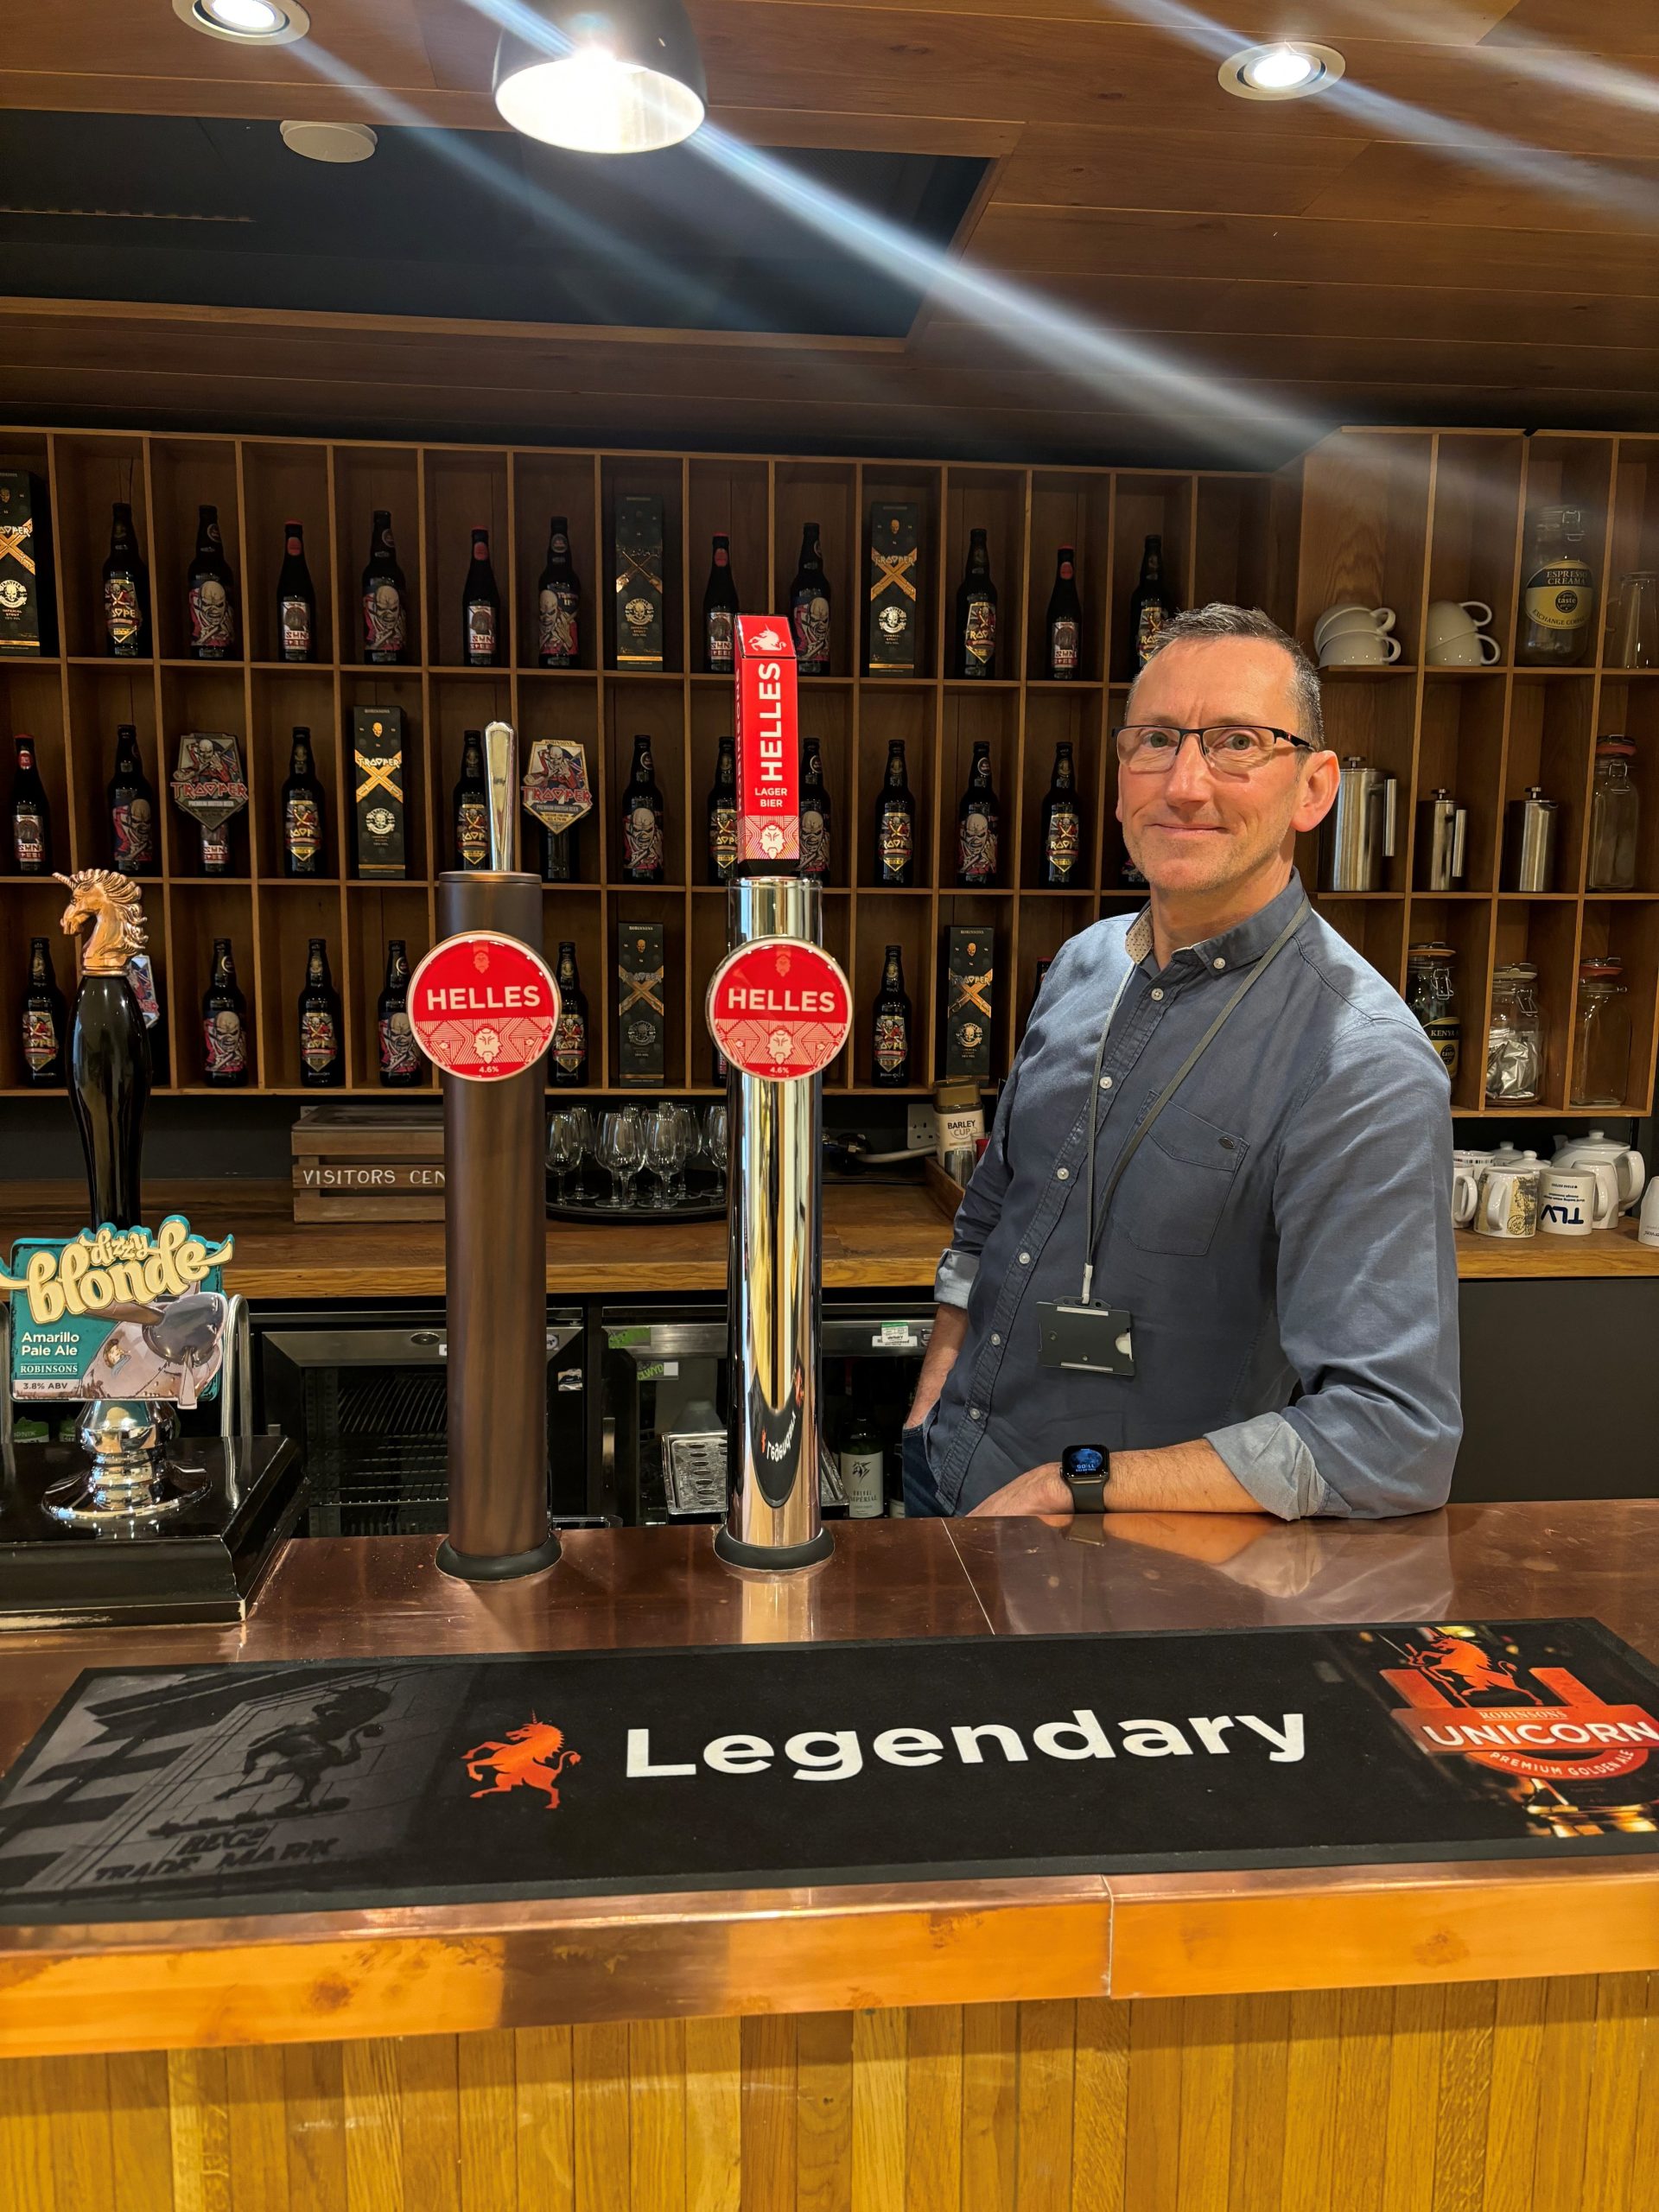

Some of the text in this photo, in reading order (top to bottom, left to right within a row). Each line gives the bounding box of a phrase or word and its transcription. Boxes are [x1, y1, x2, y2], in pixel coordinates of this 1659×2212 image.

[758, 662, 783, 781] HELLES
[170, 781, 249, 800] TROOPER
[520, 785, 594, 806] TROOPER
[754, 787, 788, 797] LAGER
[760, 799, 784, 808] BIER
[427, 985, 541, 1011] HELLES
[728, 988, 836, 1013] HELLES
[479, 1065, 499, 1074] 4.6%
[770, 1066, 790, 1075] 4.6%
[947, 1120, 976, 1130] BARLEY
[953, 1128, 971, 1136] CUP
[302, 1169, 446, 1185] VISITORS CEN
[1541, 1205, 1585, 1224] TLV
[82, 1227, 157, 1267] dizzy
[0, 1220, 233, 1325] blonde
[21, 1332, 79, 1344] Amarillo
[22, 1344, 79, 1357] Pale Ale
[20, 1364, 79, 1374] ROBINSONS
[1479, 1710, 1569, 1720] ROBINSONS
[1422, 1721, 1659, 1747] UNICORN
[626, 1709, 1306, 1781] Legendary
[1489, 1749, 1635, 1777] PREMIUM GOLDEN ALE
[92, 1838, 340, 1882] TRADE MARK
